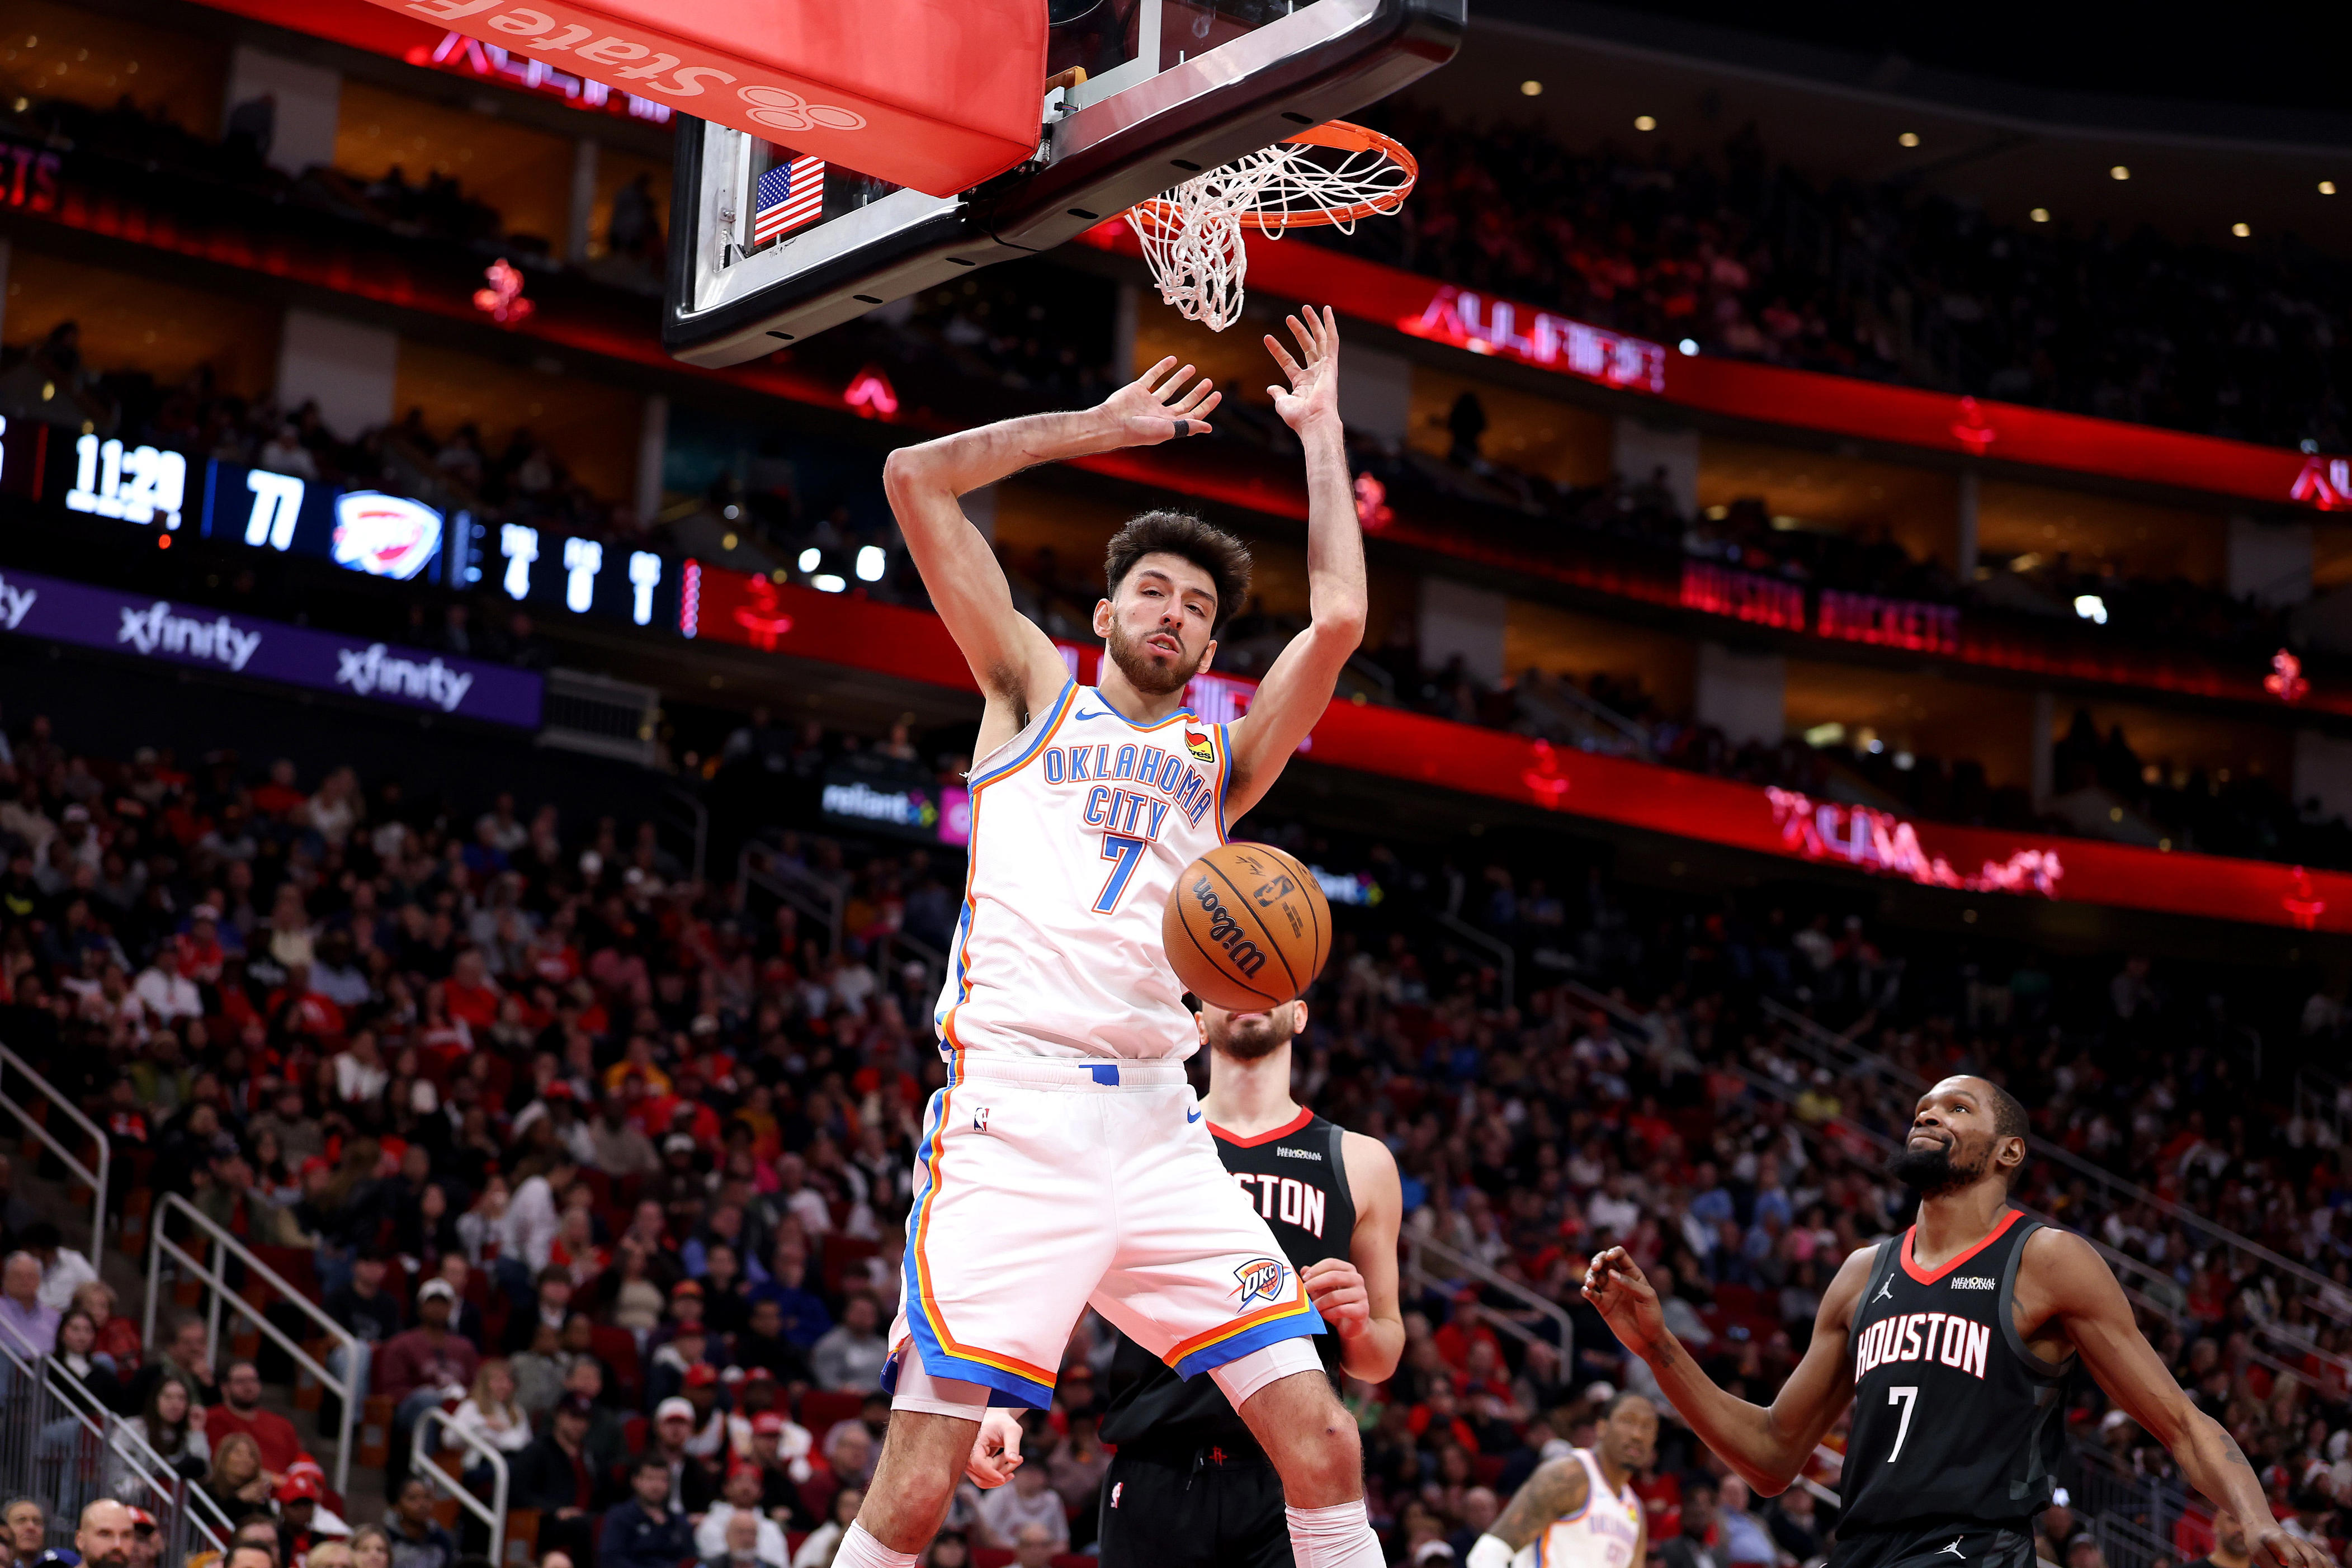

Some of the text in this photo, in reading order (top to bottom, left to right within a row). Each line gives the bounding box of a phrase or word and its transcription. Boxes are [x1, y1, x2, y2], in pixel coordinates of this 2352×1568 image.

[116, 600, 263, 670] xfinity
[336, 643, 474, 713] xfinity
[1043, 743, 1213, 829] OKLAHOMA
[1084, 785, 1170, 842] CITY
[1092, 832, 1147, 915] 7
[1192, 875, 1267, 980] Wilson
[1234, 1172, 1326, 1240] STON
[1242, 1264, 1277, 1302] OKC
[1952, 1277, 1995, 1285] MEMORIAL
[1854, 1311, 1991, 1384] HOUSTON
[1887, 1386, 1918, 1463] 7
